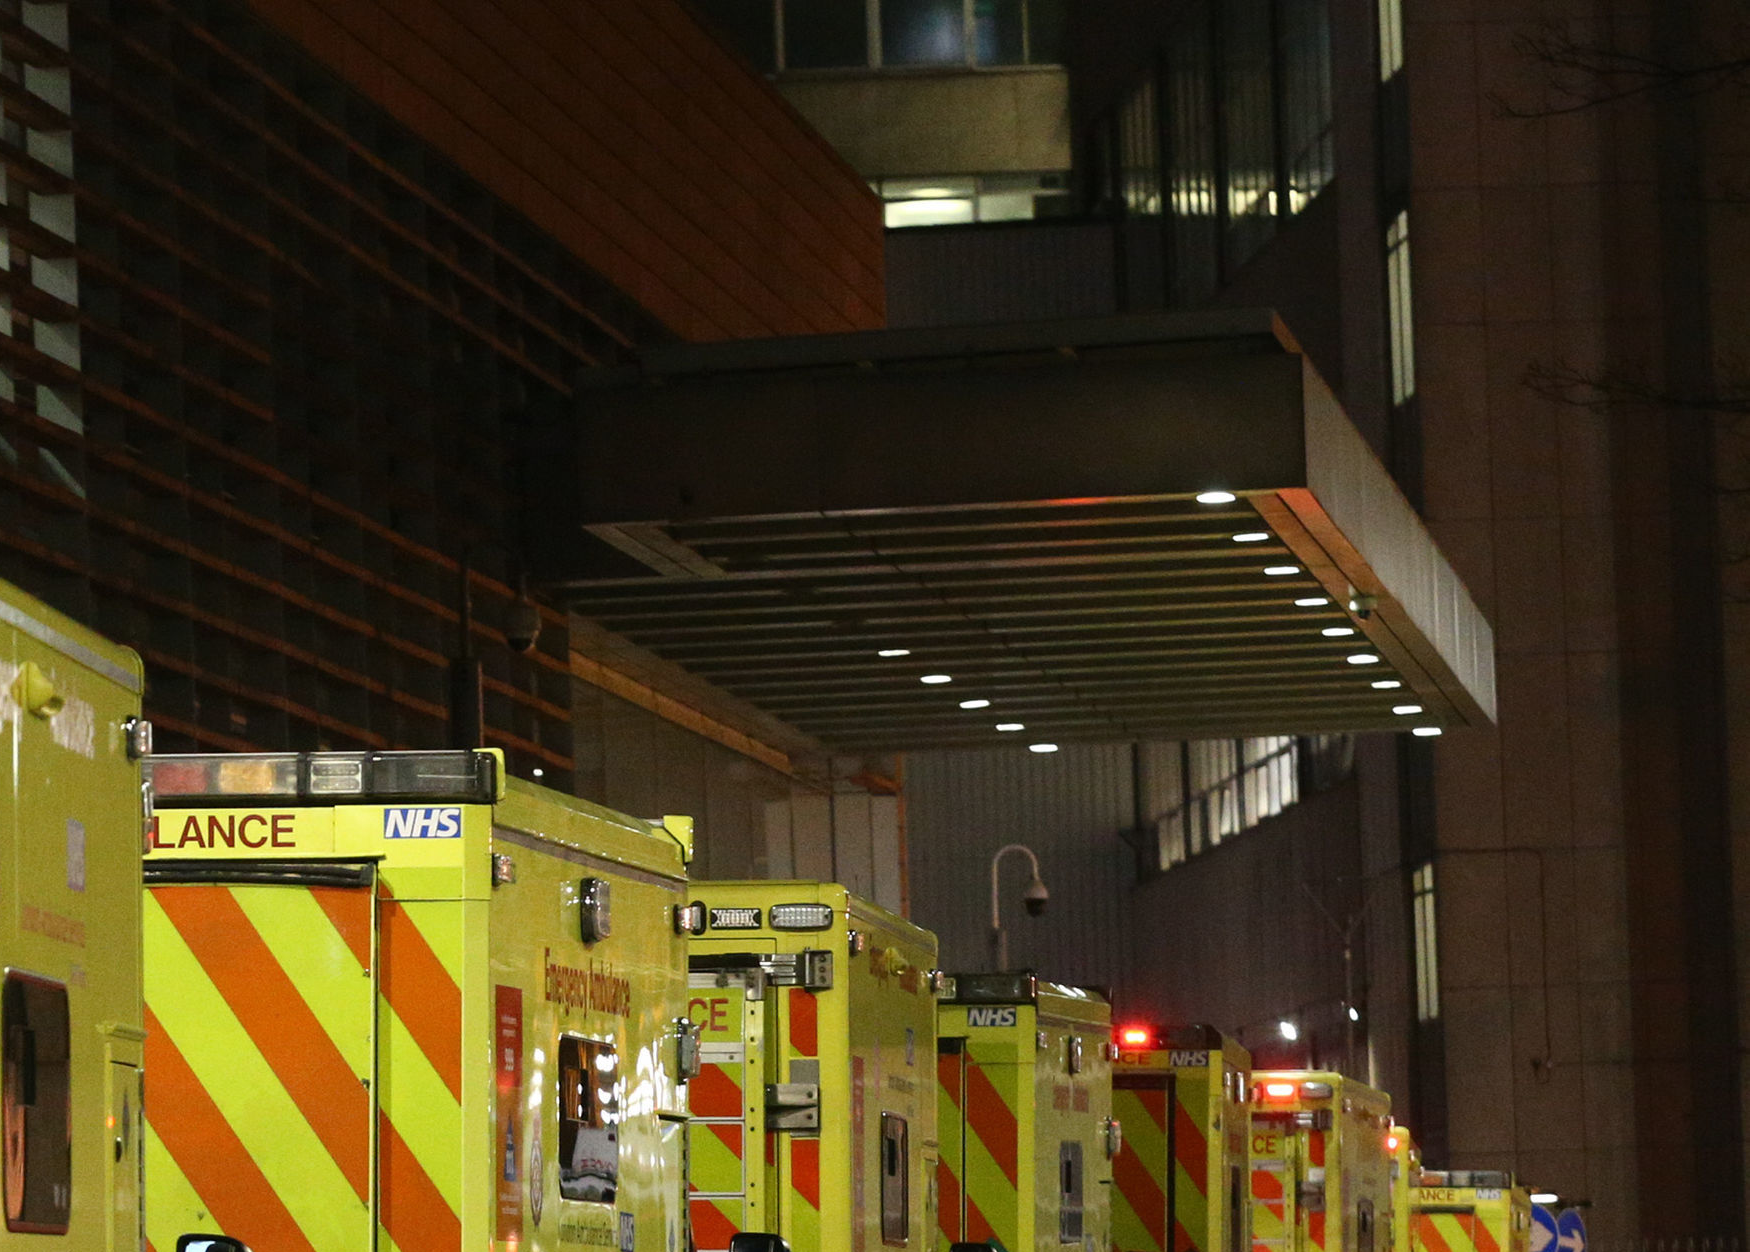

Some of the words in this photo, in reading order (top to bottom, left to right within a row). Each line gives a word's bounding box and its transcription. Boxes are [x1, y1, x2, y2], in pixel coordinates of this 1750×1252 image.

[152, 813, 296, 849] LANCE
[385, 808, 460, 838] NHS
[544, 946, 587, 1019] Emergency
[588, 957, 631, 1018] Ambulance
[688, 998, 729, 1031] CE
[968, 1007, 1016, 1027] NHS
[1115, 1050, 1152, 1066] CE
[1169, 1050, 1208, 1067] NHS
[1252, 1135, 1276, 1154] CE
